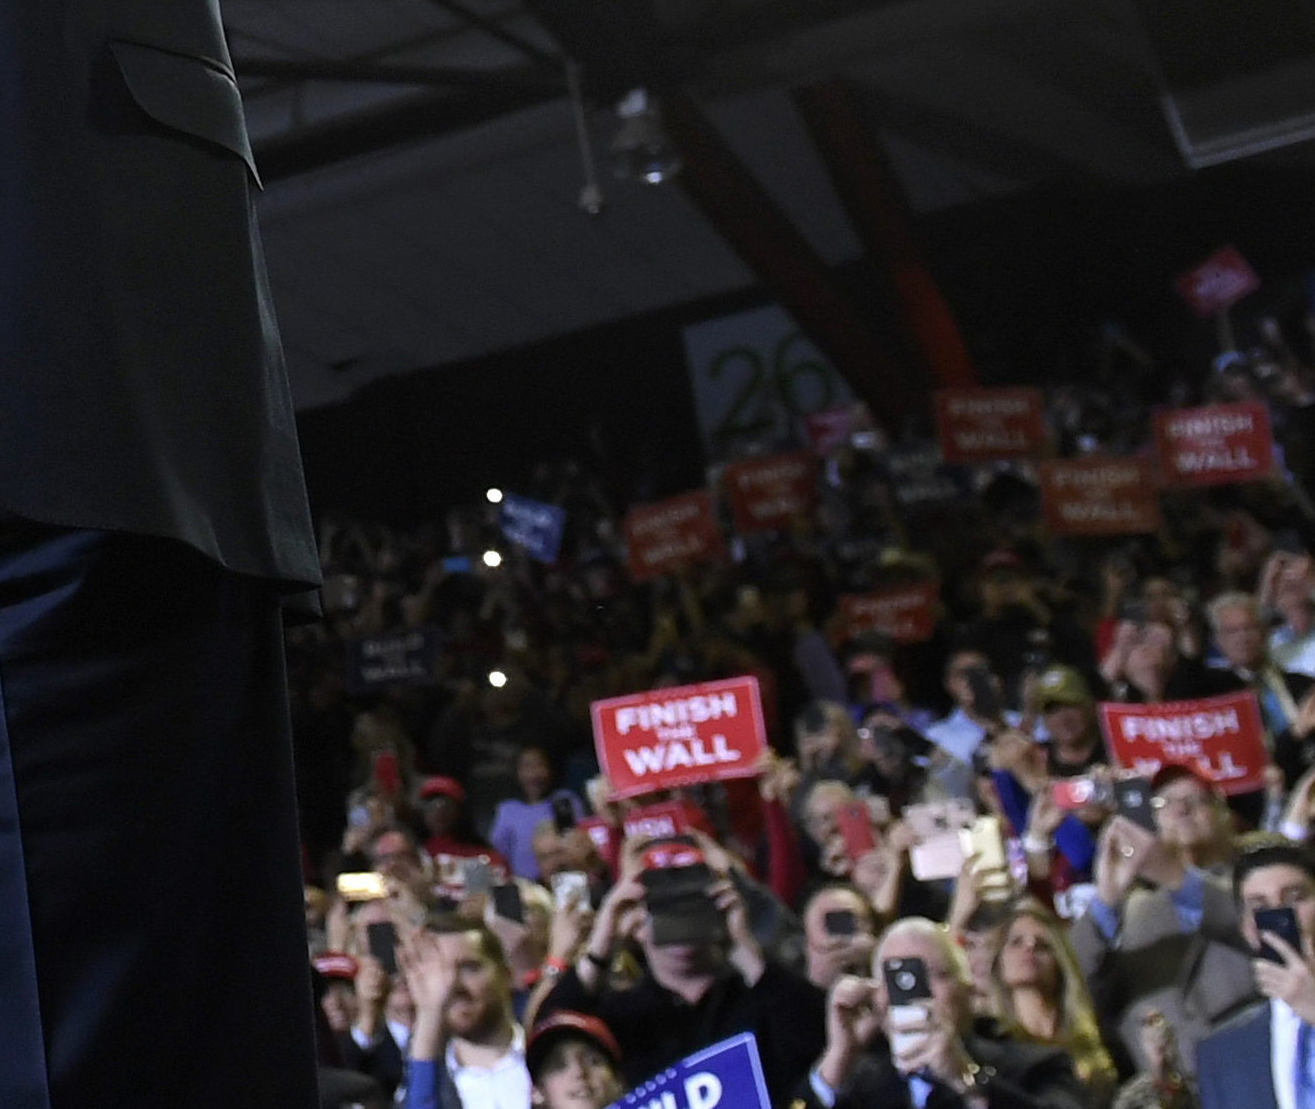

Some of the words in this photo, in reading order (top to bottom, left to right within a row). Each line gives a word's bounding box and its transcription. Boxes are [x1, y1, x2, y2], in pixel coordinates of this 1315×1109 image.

[708, 331, 837, 439] 26
[1174, 445, 1259, 476] WALL
[615, 692, 738, 736] FINISH
[1121, 709, 1239, 743] FINISH
[623, 734, 742, 776] WALL
